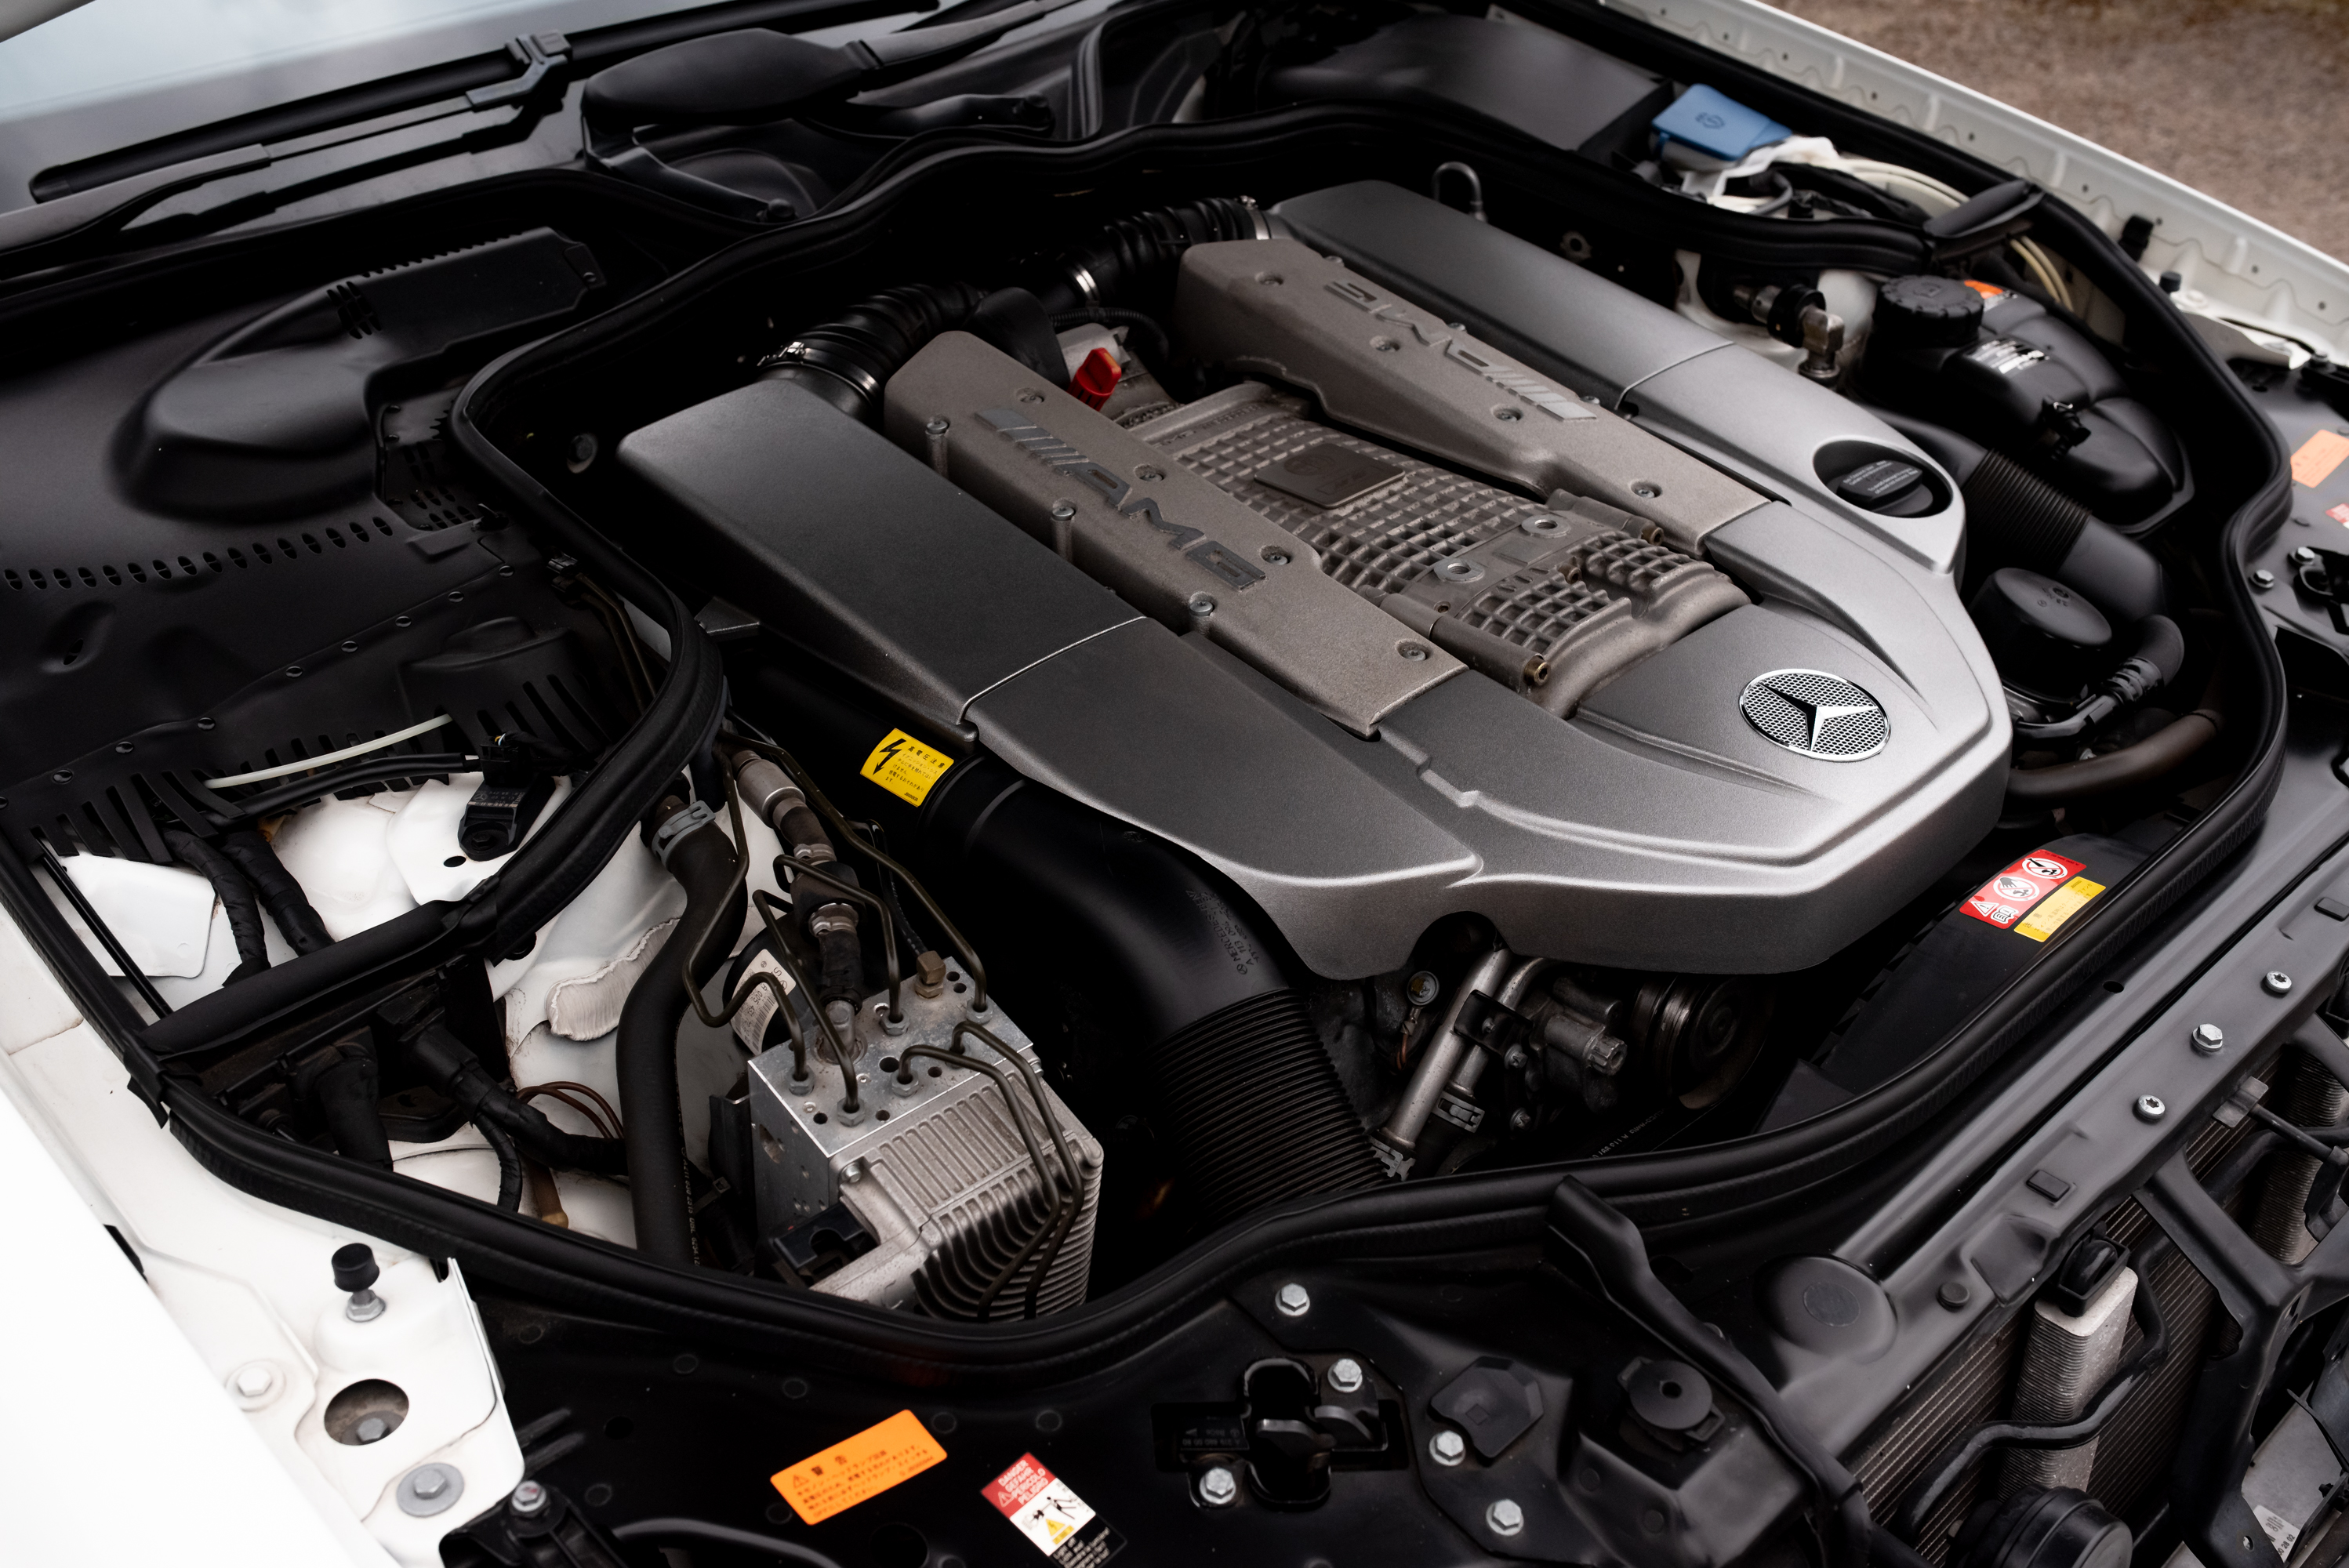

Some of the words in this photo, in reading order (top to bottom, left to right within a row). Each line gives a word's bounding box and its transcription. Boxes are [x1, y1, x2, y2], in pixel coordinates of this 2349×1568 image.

[997, 1458, 1029, 1487] DANGER
[1004, 1465, 1034, 1493] GEFAHR
[1010, 1466, 1047, 1499] PERICOLO
[1016, 1475, 1049, 1505] PELIGRO
